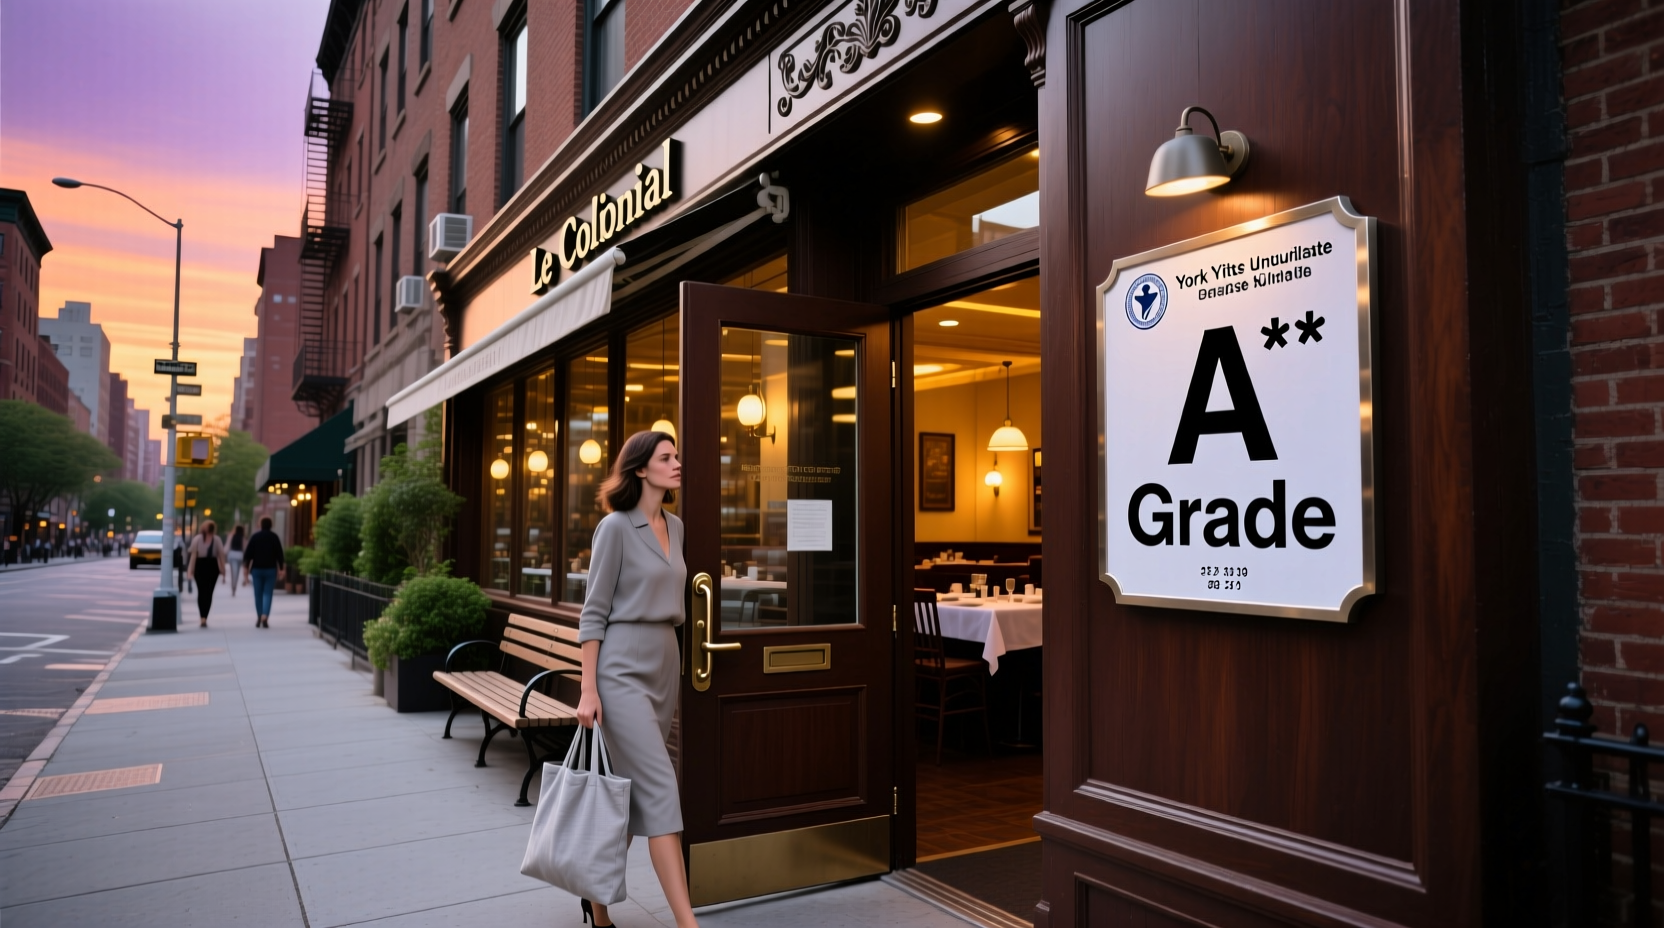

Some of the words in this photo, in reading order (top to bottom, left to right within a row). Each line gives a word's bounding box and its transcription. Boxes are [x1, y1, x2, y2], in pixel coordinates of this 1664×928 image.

[529, 247, 553, 294] Le
[1175, 268, 1208, 290] York
[1127, 479, 1337, 550] Grade
